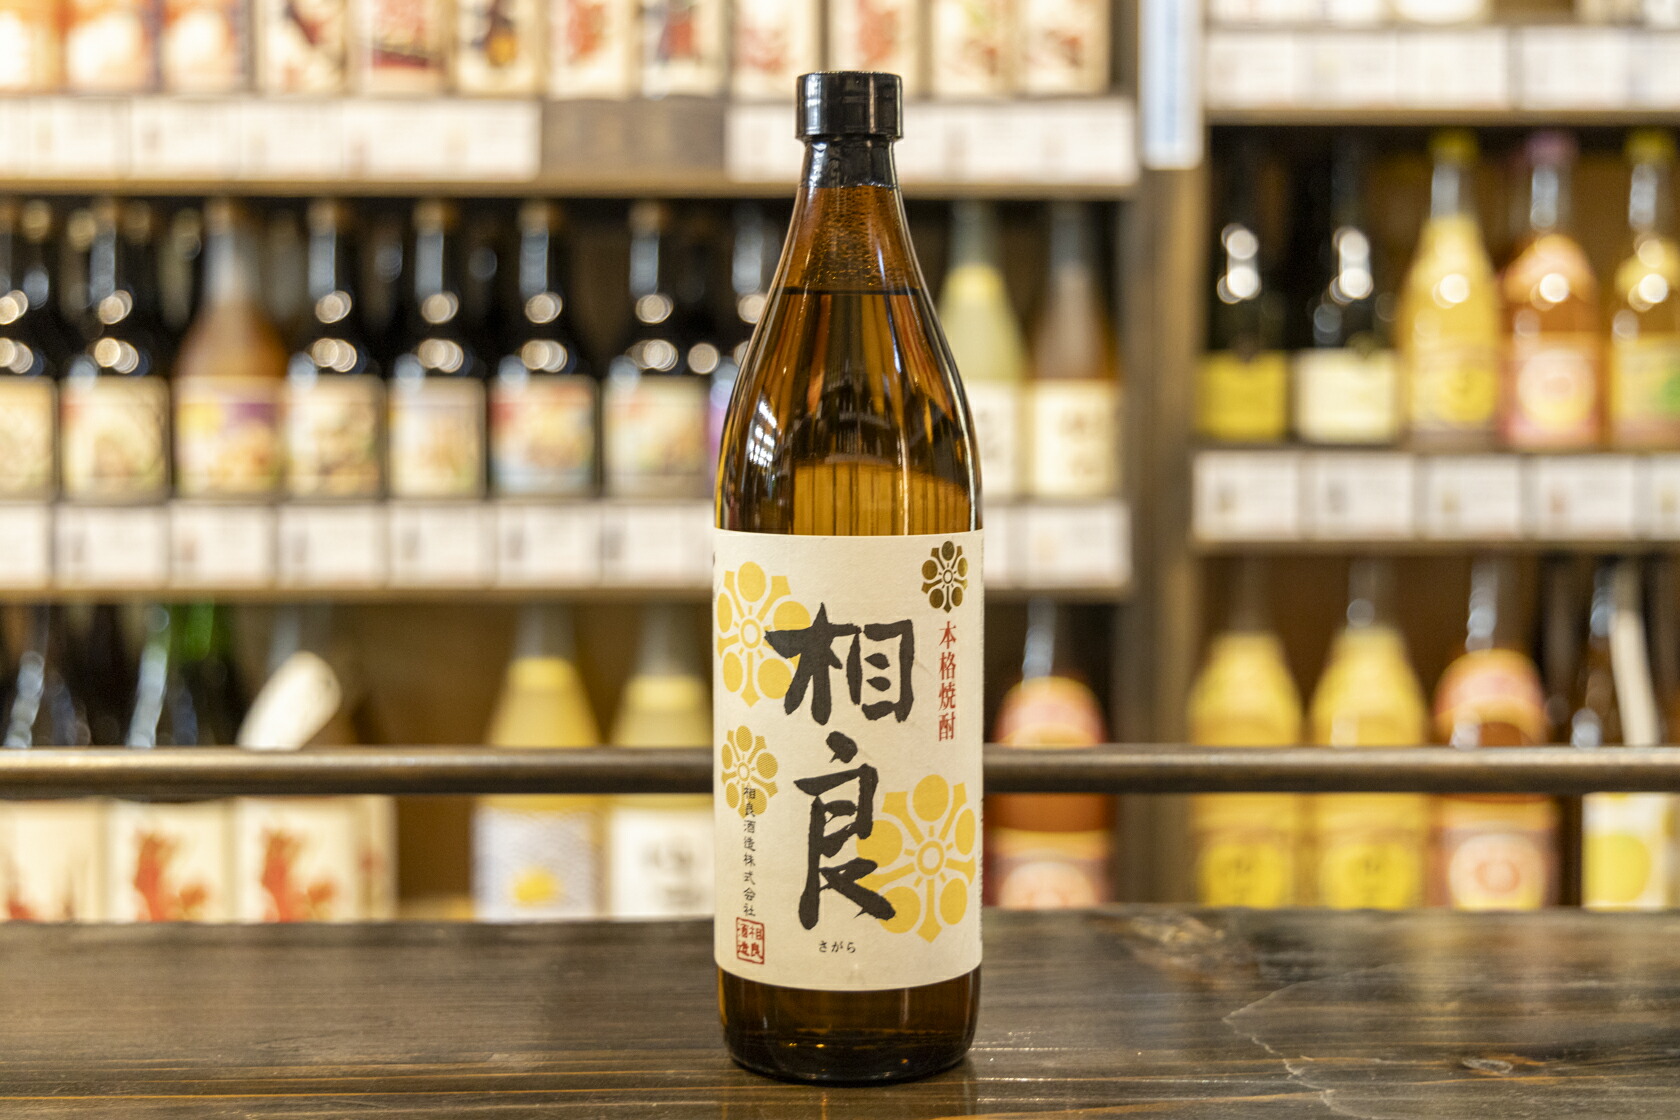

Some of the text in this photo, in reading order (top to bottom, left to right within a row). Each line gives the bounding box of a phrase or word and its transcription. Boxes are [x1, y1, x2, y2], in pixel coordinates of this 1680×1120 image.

[938, 620, 957, 742] 本格焼酎
[765, 603, 914, 930] 相良
[743, 787, 757, 917] 相良酒造株式会社
[818, 940, 857, 954] さがら
